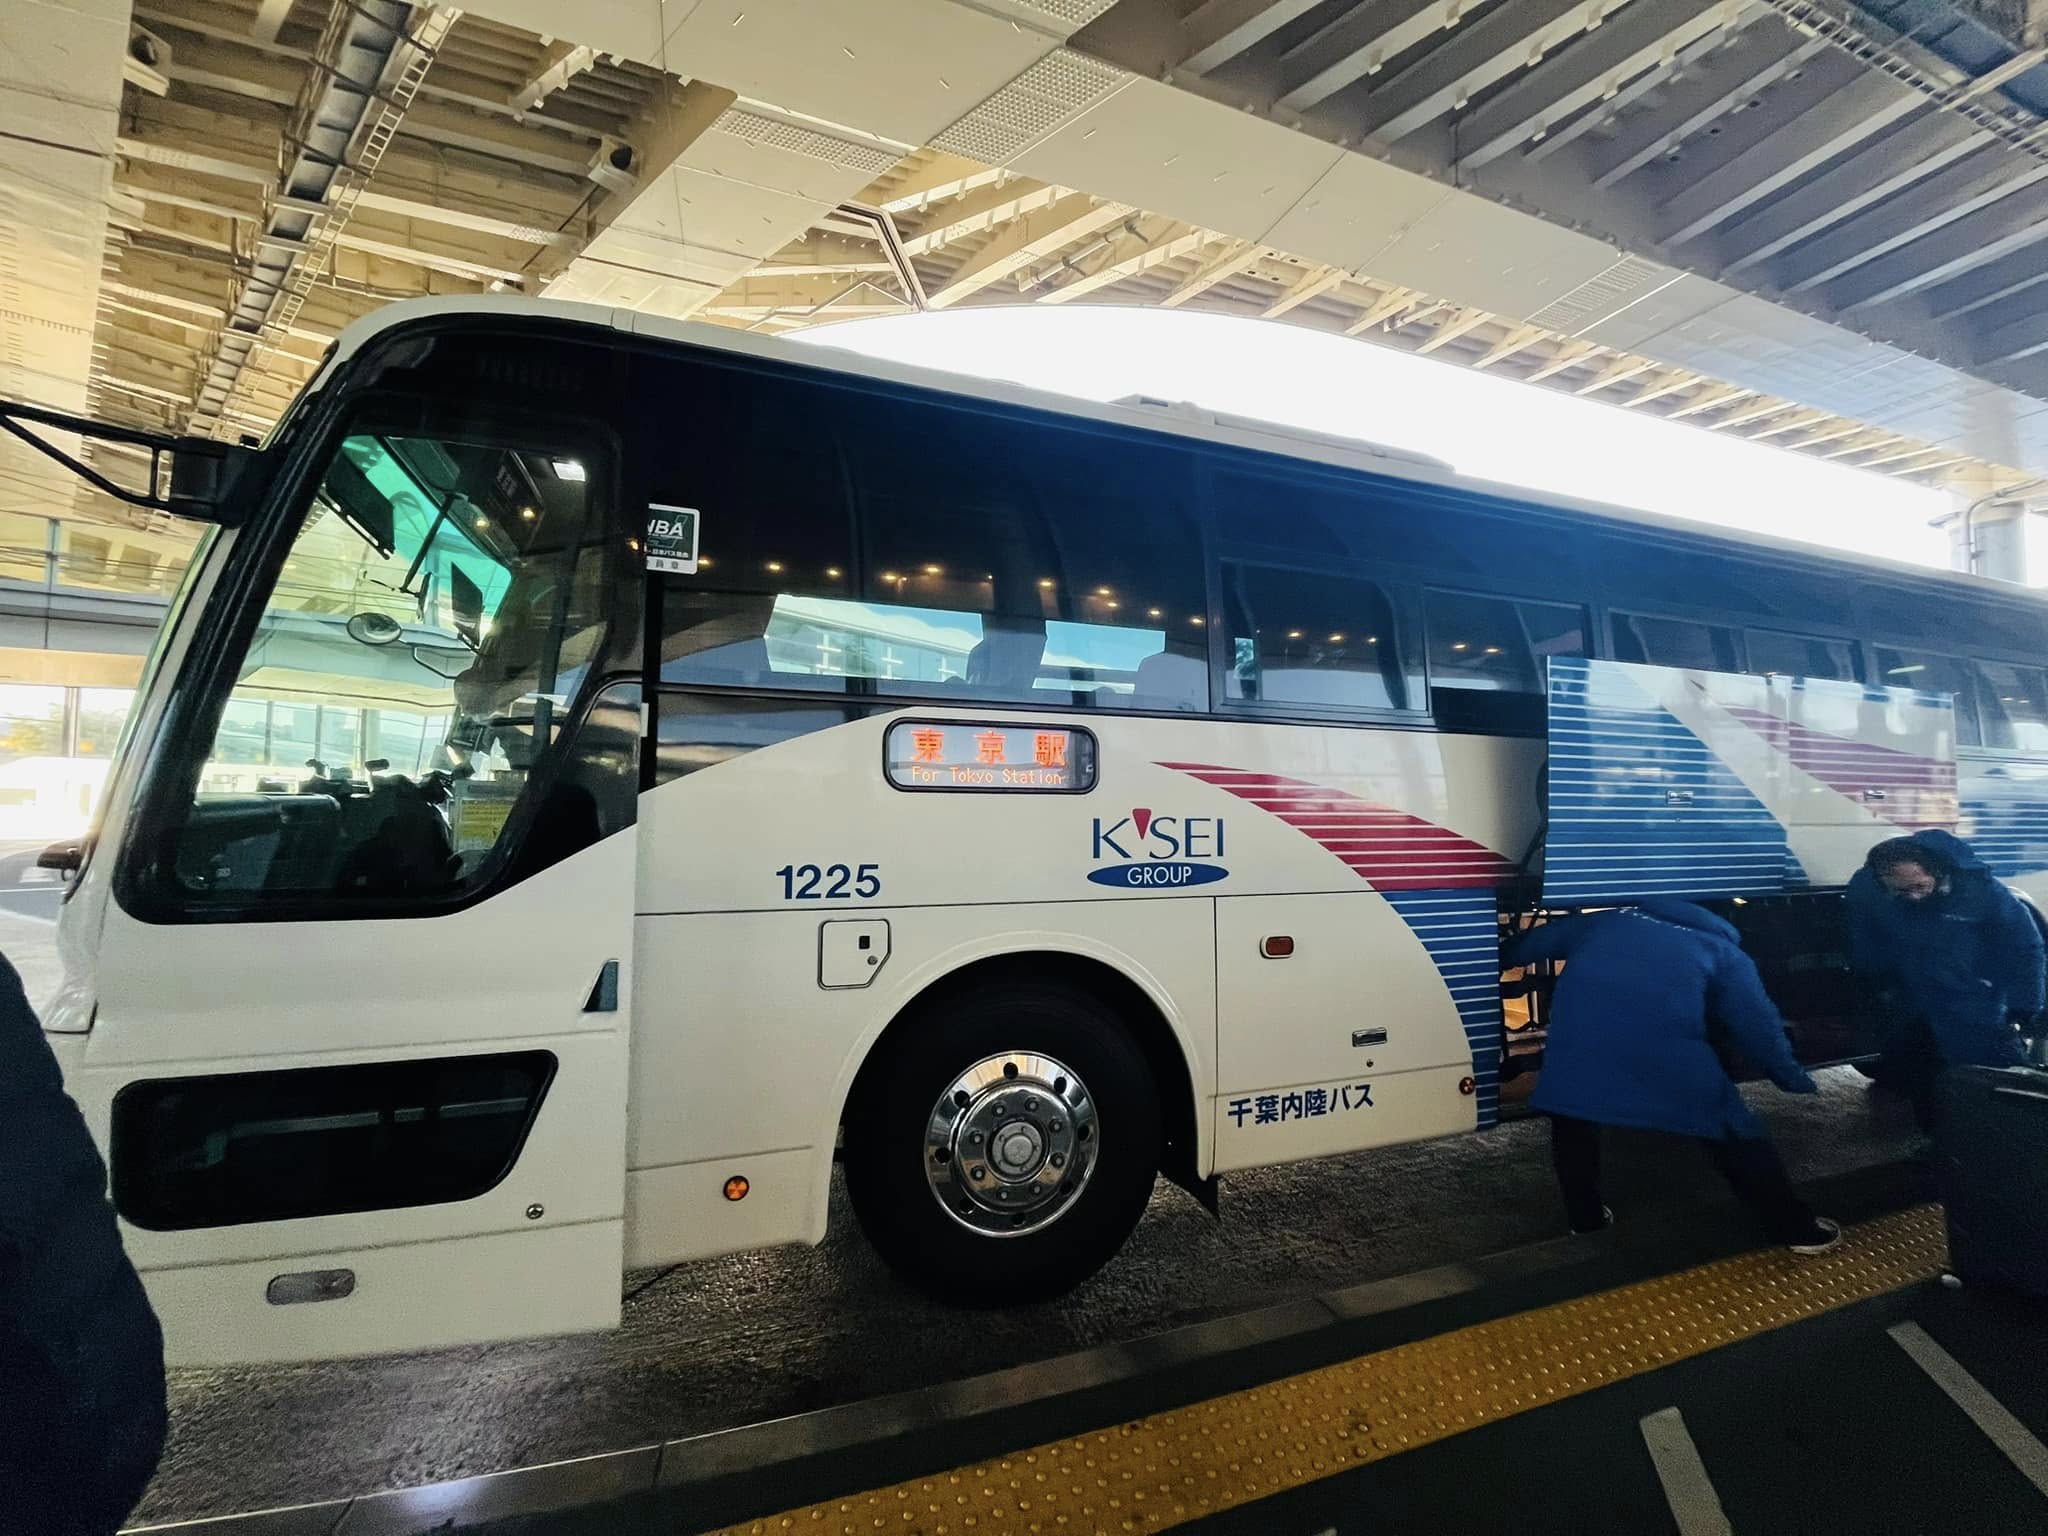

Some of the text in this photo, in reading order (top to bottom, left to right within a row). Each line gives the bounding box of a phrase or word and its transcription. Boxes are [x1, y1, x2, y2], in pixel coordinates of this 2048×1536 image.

[911, 728, 1067, 767] 東京駅
[912, 765, 1065, 784] For Tokyo Station
[776, 863, 881, 900] 1225
[1127, 866, 1192, 884] GROUP
[1227, 1083, 1374, 1128] 千葉内陸バス
